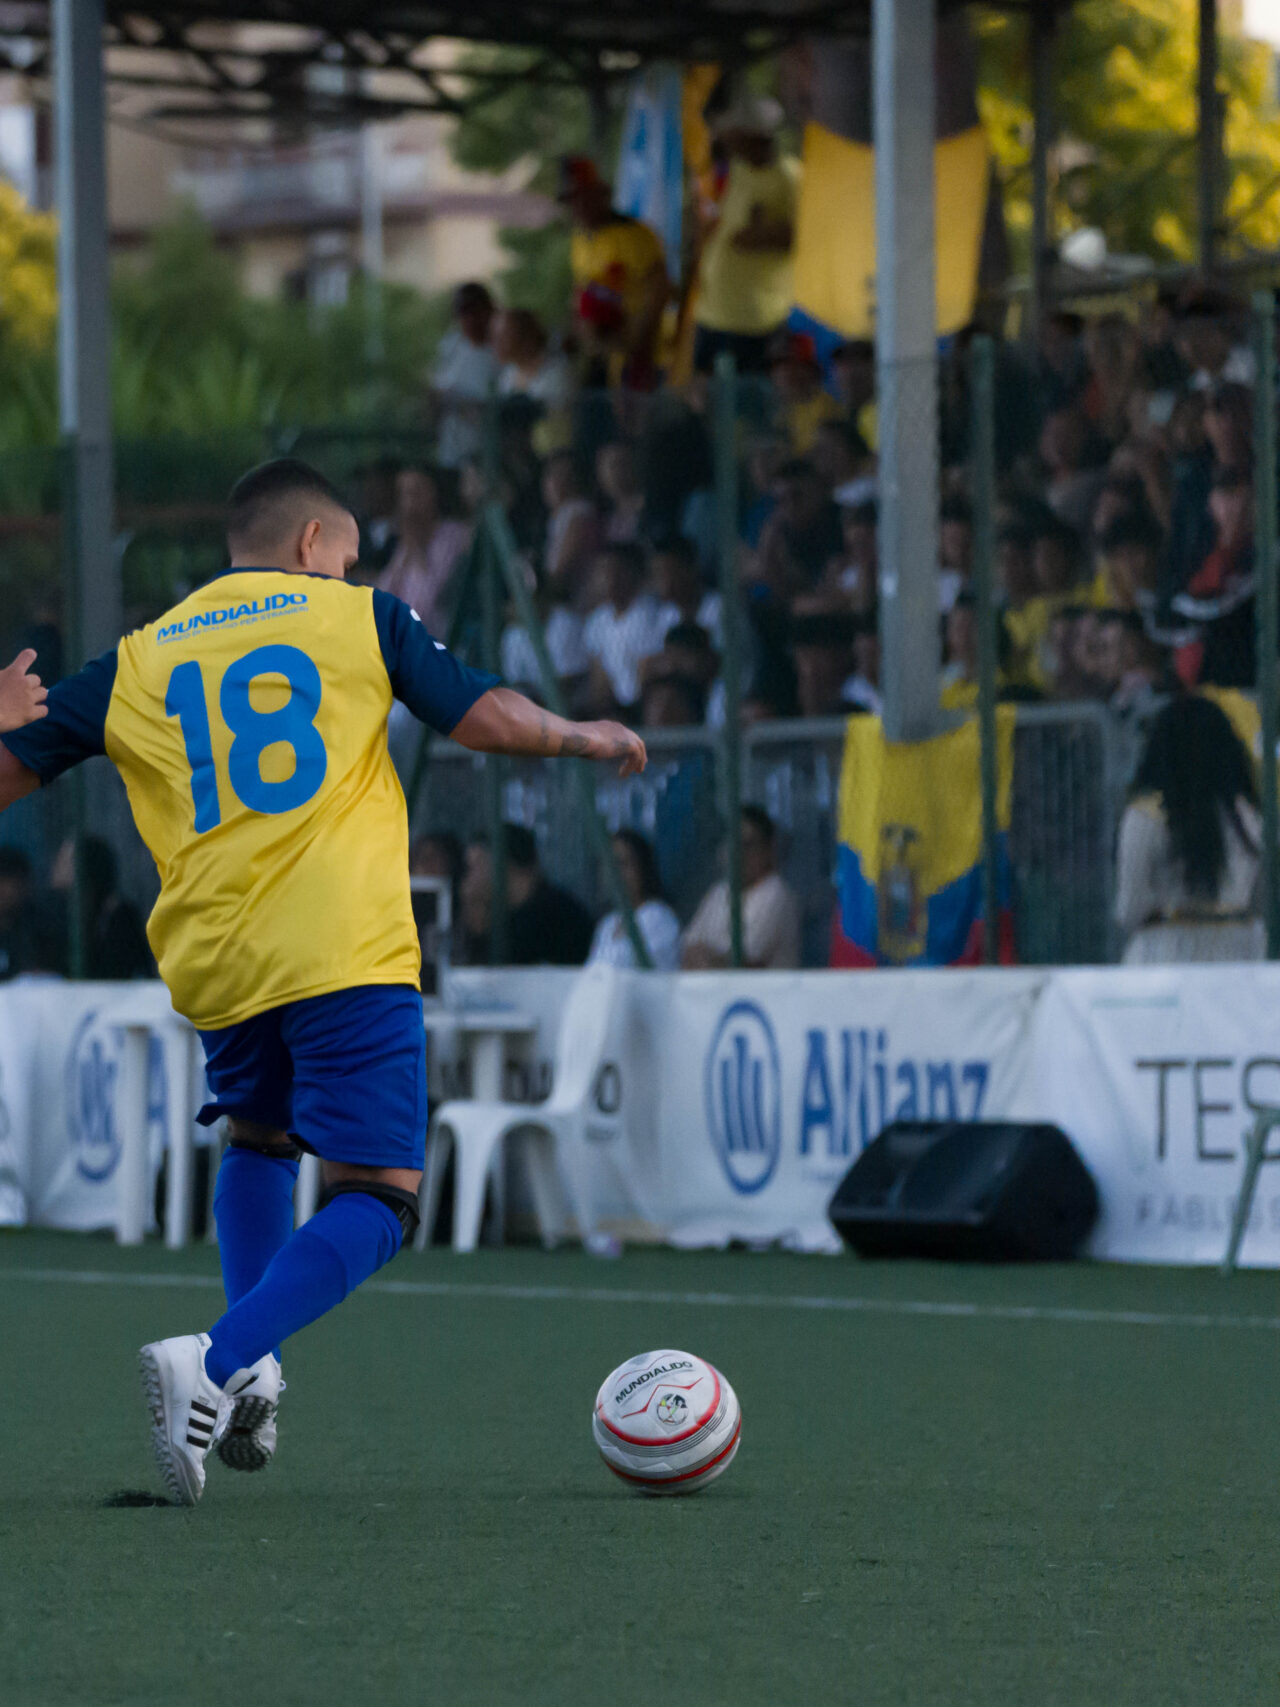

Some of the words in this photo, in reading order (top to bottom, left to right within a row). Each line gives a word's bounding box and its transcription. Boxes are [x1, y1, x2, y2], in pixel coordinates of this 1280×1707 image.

[156, 593, 308, 641] MUNDIALIDO
[164, 643, 328, 835] 18
[797, 1026, 991, 1157] Allianz
[615, 1360, 694, 1404] MUNDIALIDO
